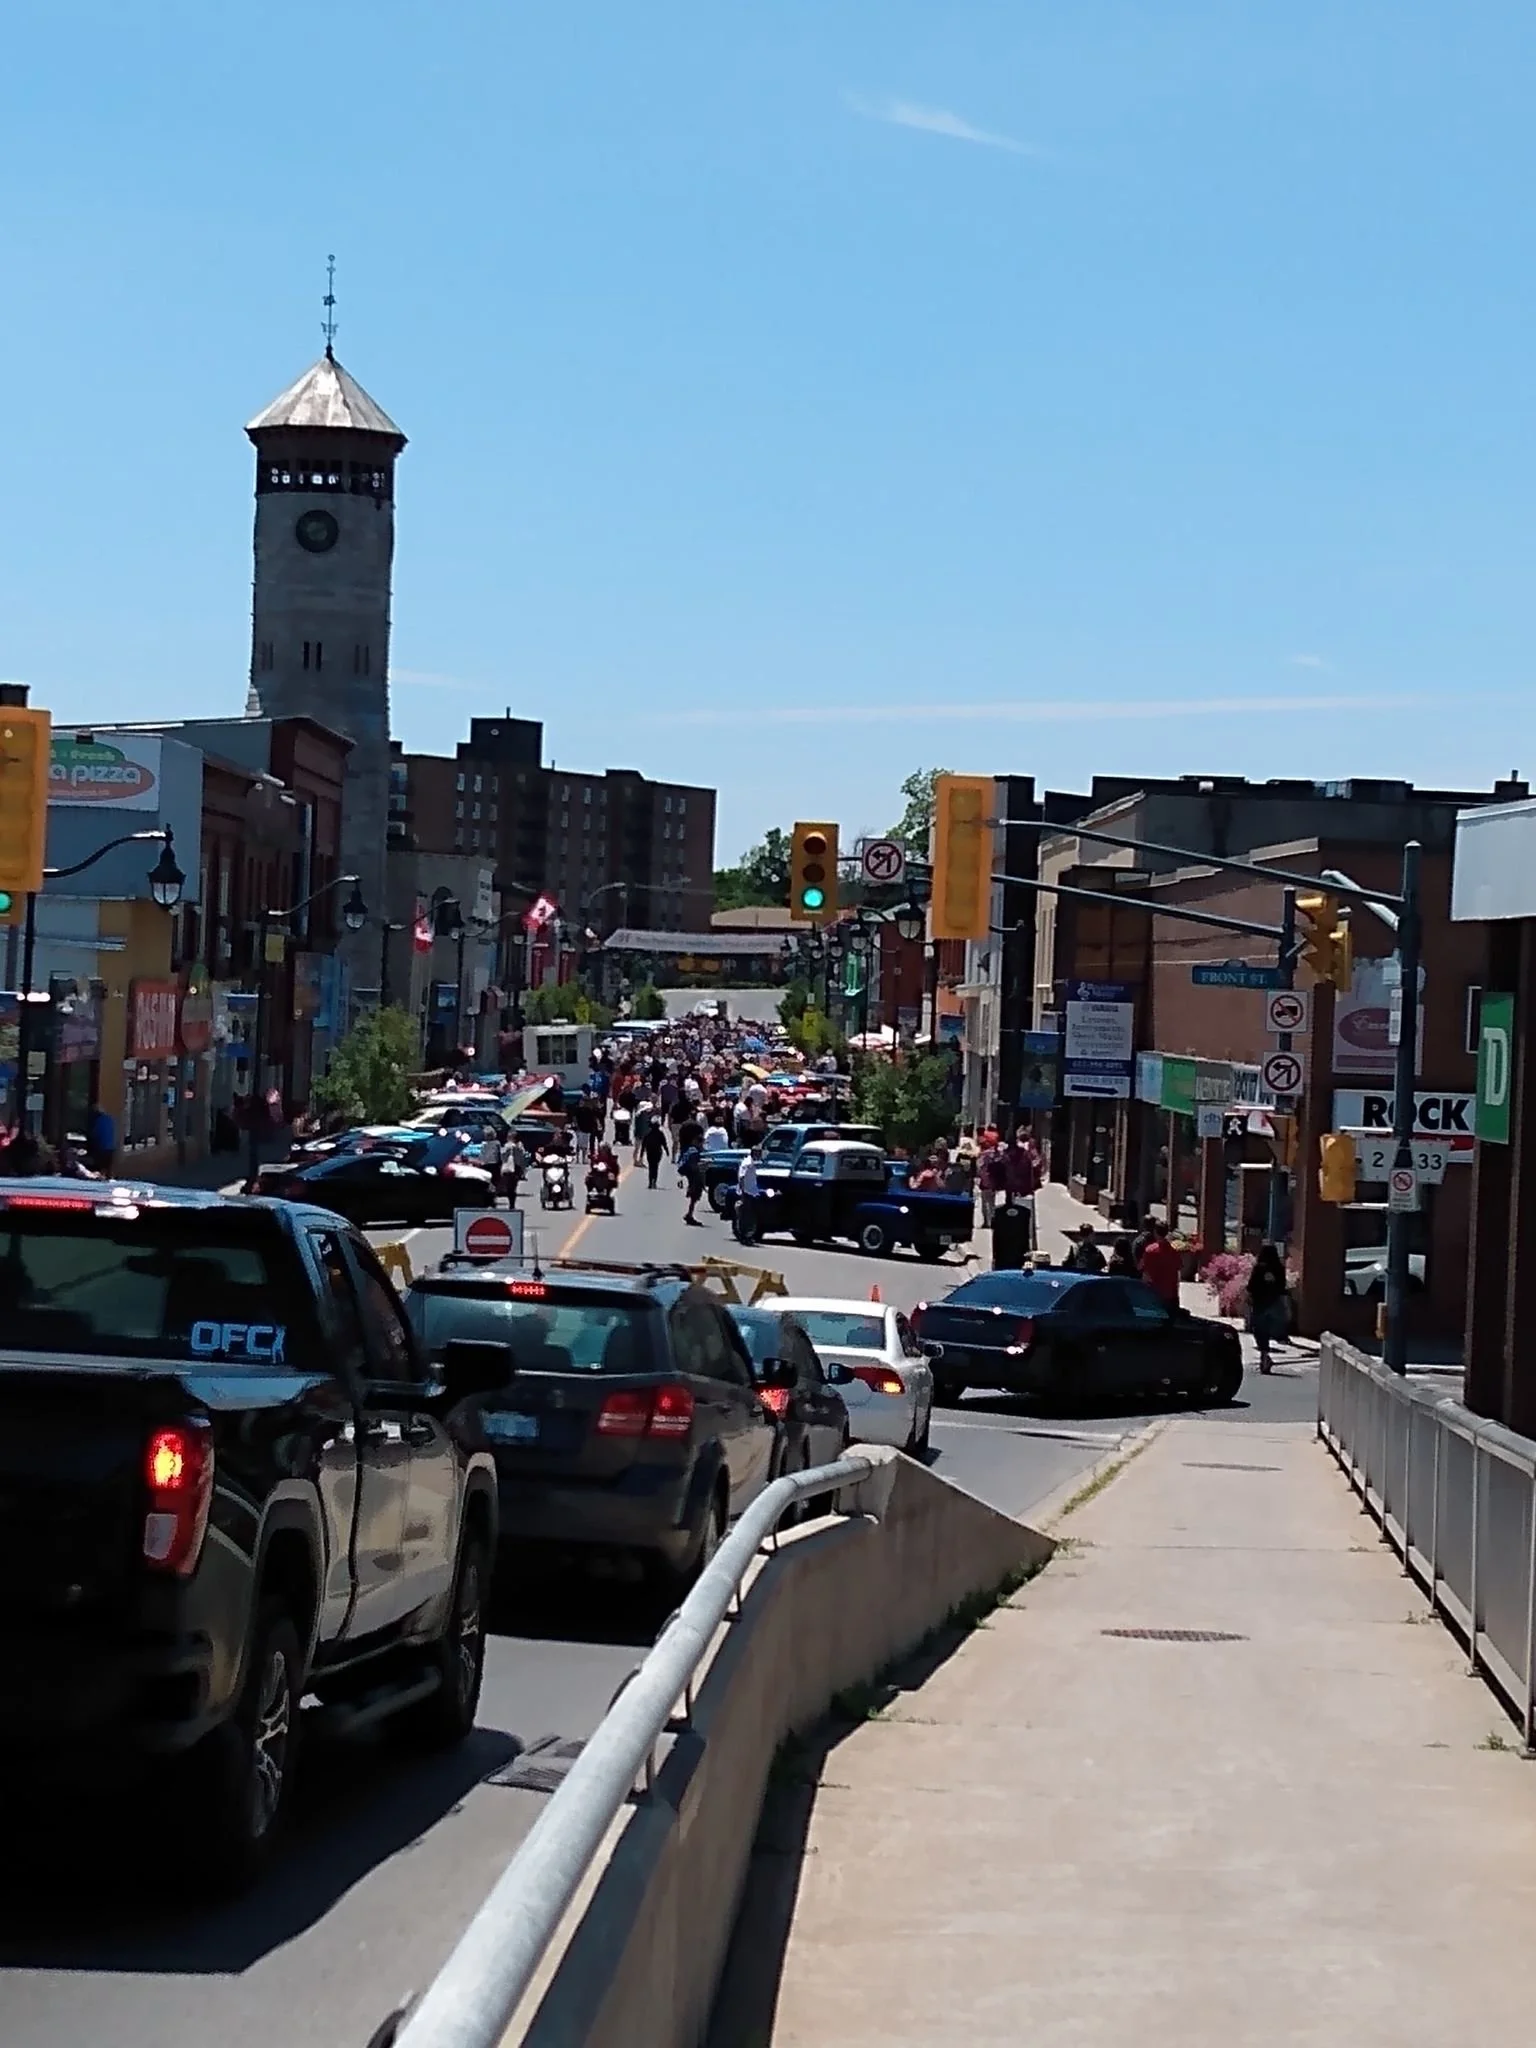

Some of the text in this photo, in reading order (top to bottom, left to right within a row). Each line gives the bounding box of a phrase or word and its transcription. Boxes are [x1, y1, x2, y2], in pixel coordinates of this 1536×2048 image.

[70, 764, 141, 787] pizza
[1200, 972, 1247, 984] FRONT
[1363, 1095, 1470, 1131] RCK
[1372, 1152, 1384, 1168] 2
[1418, 1154, 1442, 1170] 33
